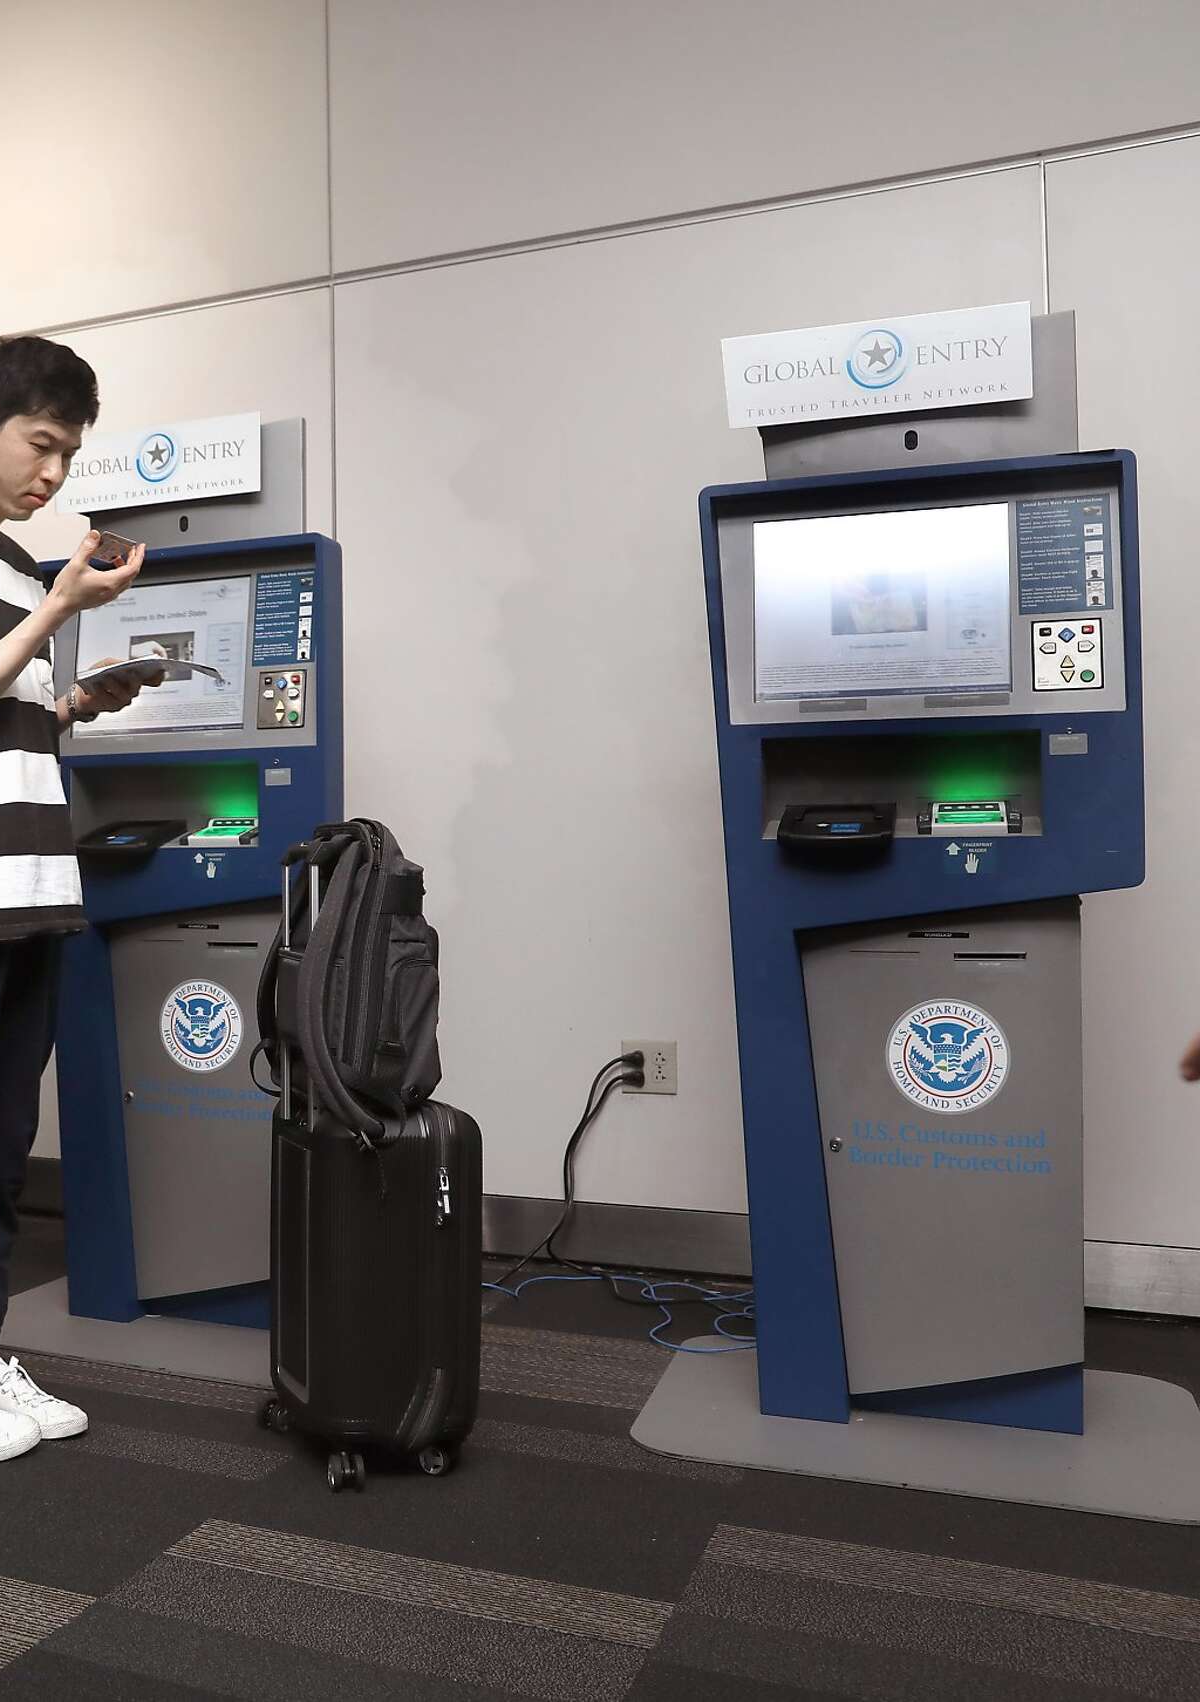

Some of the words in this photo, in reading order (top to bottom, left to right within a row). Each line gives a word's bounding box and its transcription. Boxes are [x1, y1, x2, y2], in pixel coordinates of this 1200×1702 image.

[743, 356, 841, 386] GLOBAL
[915, 335, 1009, 366] ENTRY
[746, 402, 819, 418] TRUSTED
[830, 392, 912, 410] TRAVELER
[923, 382, 1010, 400] NETWORK
[68, 455, 132, 479] GLOBAL
[183, 439, 246, 464] ENTRY
[176, 984, 231, 1007] DEPARTMENT
[229, 1009, 239, 1021] OF
[911, 1005, 993, 1034] DEPARTMENT
[989, 1034, 1003, 1050] OF
[163, 1029, 202, 1069] HOMELAND
[204, 1032, 239, 1069] SECURITY
[893, 1060, 950, 1109] HOMELAND
[955, 1063, 1004, 1109] SECURITY
[853, 1121, 893, 1141] U.S.
[900, 1122, 997, 1147] Customs
[1006, 1130, 1046, 1149] and
[849, 1147, 925, 1168] Border
[932, 1151, 1052, 1175] Protection
